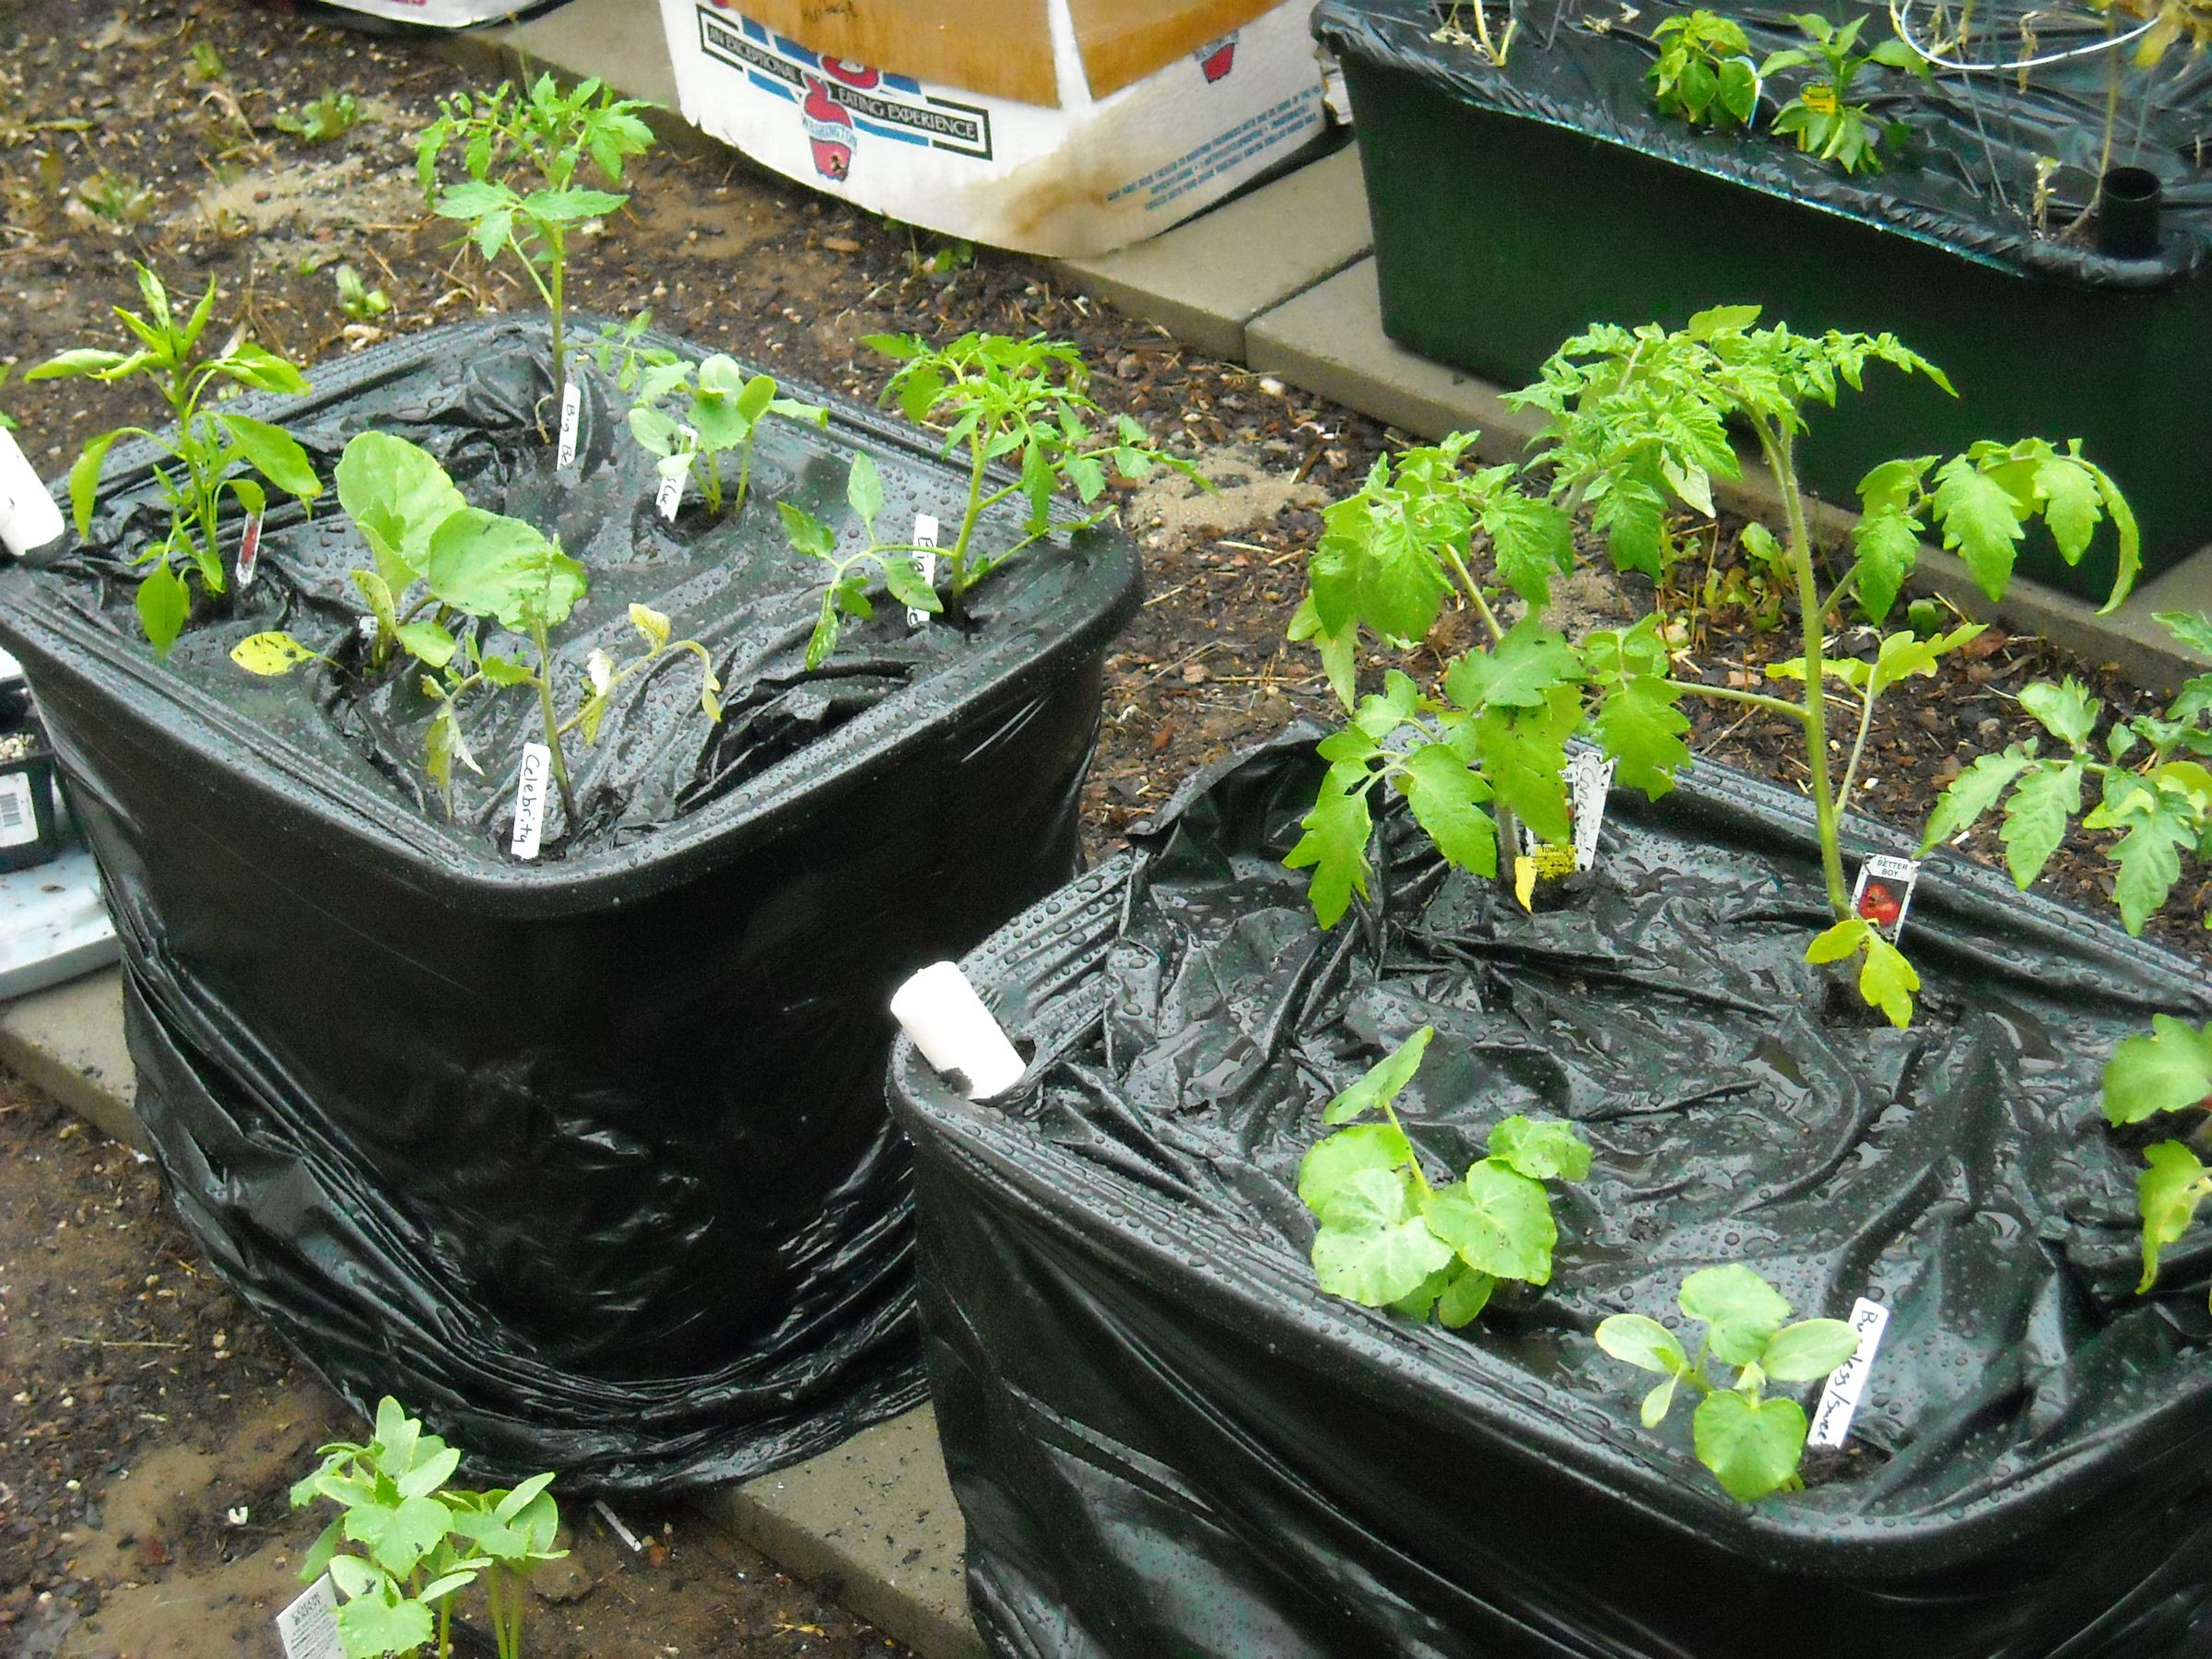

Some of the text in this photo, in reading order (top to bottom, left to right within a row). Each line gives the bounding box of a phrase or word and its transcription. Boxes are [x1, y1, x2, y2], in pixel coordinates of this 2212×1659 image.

[708, 24, 977, 139] AN EXCEPTIONAL EATING EXPERIENCE
[801, 116, 857, 154] WASHINGTON
[512, 754, 540, 843] Celebrity
[1877, 859, 1909, 871] BETTER
[1881, 868, 1900, 877] BOY
